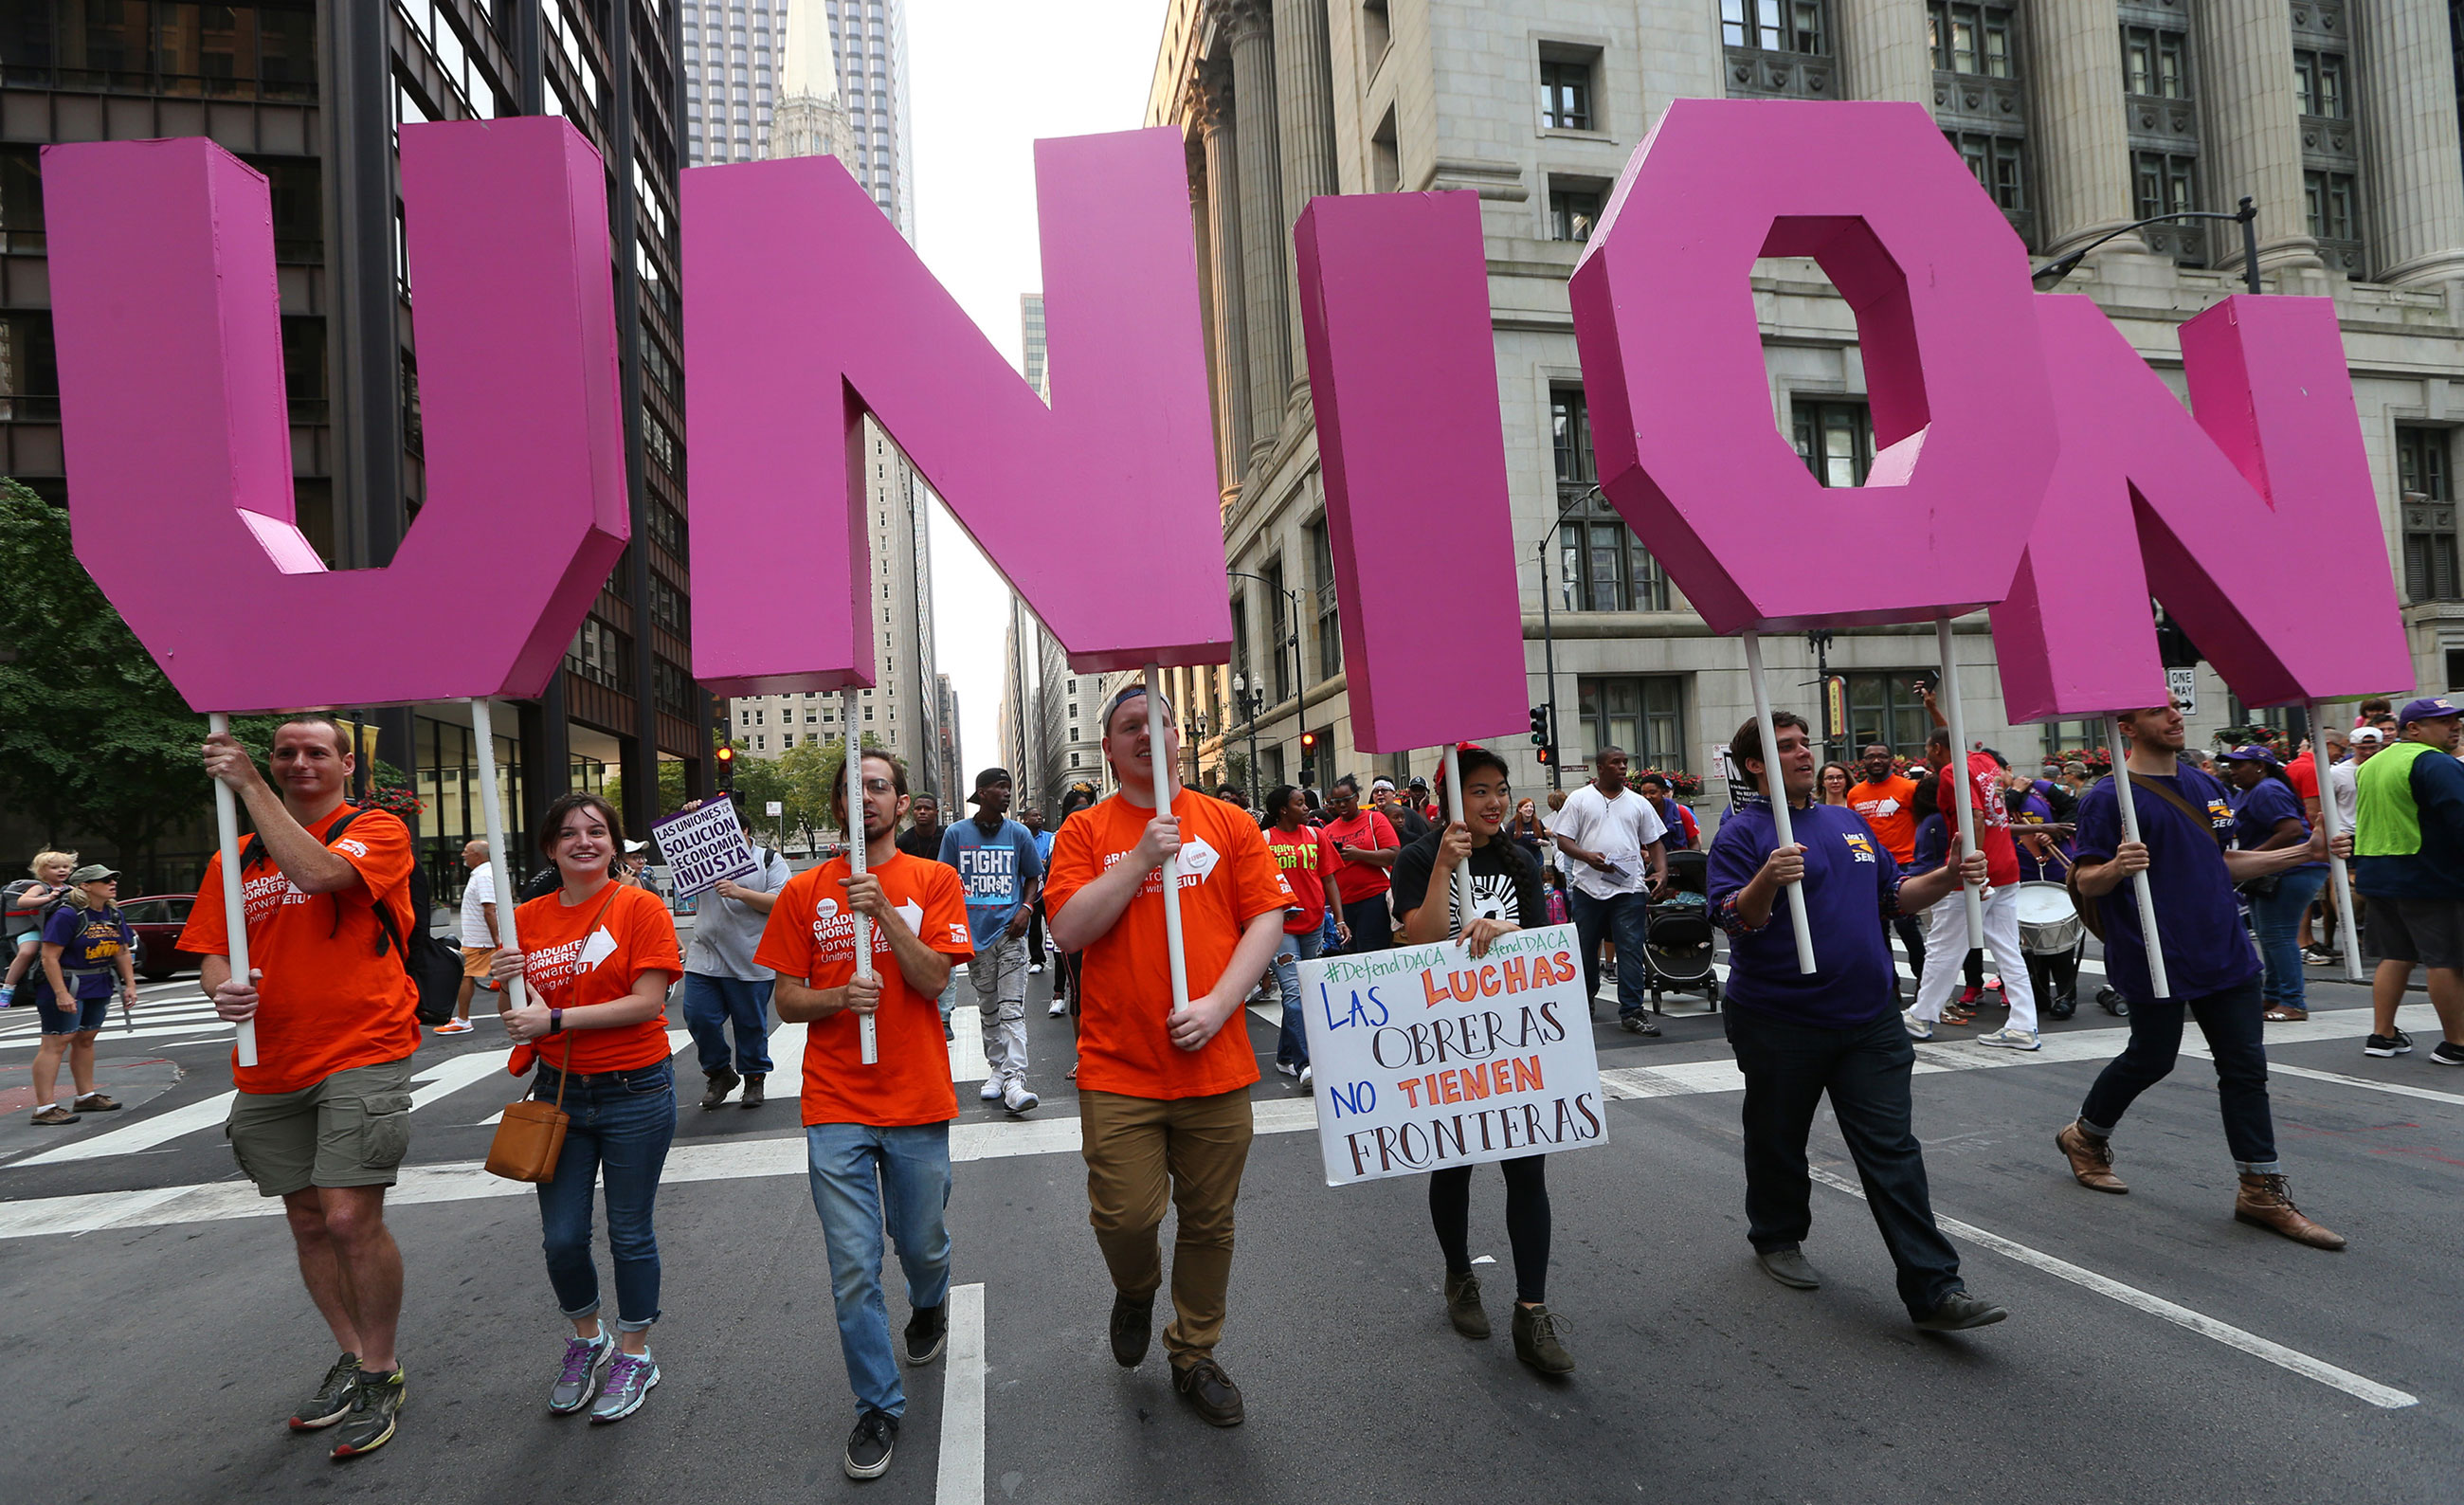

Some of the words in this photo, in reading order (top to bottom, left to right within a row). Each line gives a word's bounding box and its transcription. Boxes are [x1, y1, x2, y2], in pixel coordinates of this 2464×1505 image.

[43, 99, 2415, 752] UNION
[2172, 672, 2192, 683] ONE
[2174, 685, 2193, 697] WAY
[852, 736, 859, 751] MF
[656, 825, 677, 841] LAS
[676, 806, 720, 832] UNIONES
[2212, 818, 2235, 828] SEU
[663, 816, 736, 858] SOLUCIÓN
[676, 833, 743, 870] ECONOMÍA
[1297, 843, 1318, 870] 15
[1854, 852, 1875, 863] SEIU
[670, 860, 677, 868] A
[675, 845, 752, 889] INJUSTA
[959, 850, 1014, 874] FIGHT
[970, 875, 996, 894] FOR
[1176, 875, 1197, 889] EIU
[282, 894, 306, 905] EIU
[812, 914, 855, 932] GRADU
[819, 936, 857, 953] Forwa
[875, 941, 892, 953] SE
[821, 949, 854, 964] Uniting
[1324, 947, 1446, 984] #DefendDACA
[1465, 930, 1570, 962] #efendDACA
[1320, 982, 1389, 1031] LAS
[1421, 951, 1577, 1009] LUCHAS
[1372, 1001, 1566, 1069] OBRERAS
[1330, 1079, 1377, 1118] NO
[1397, 1054, 1546, 1108] TIENEN
[1343, 1091, 1602, 1177] FRONTERAS
